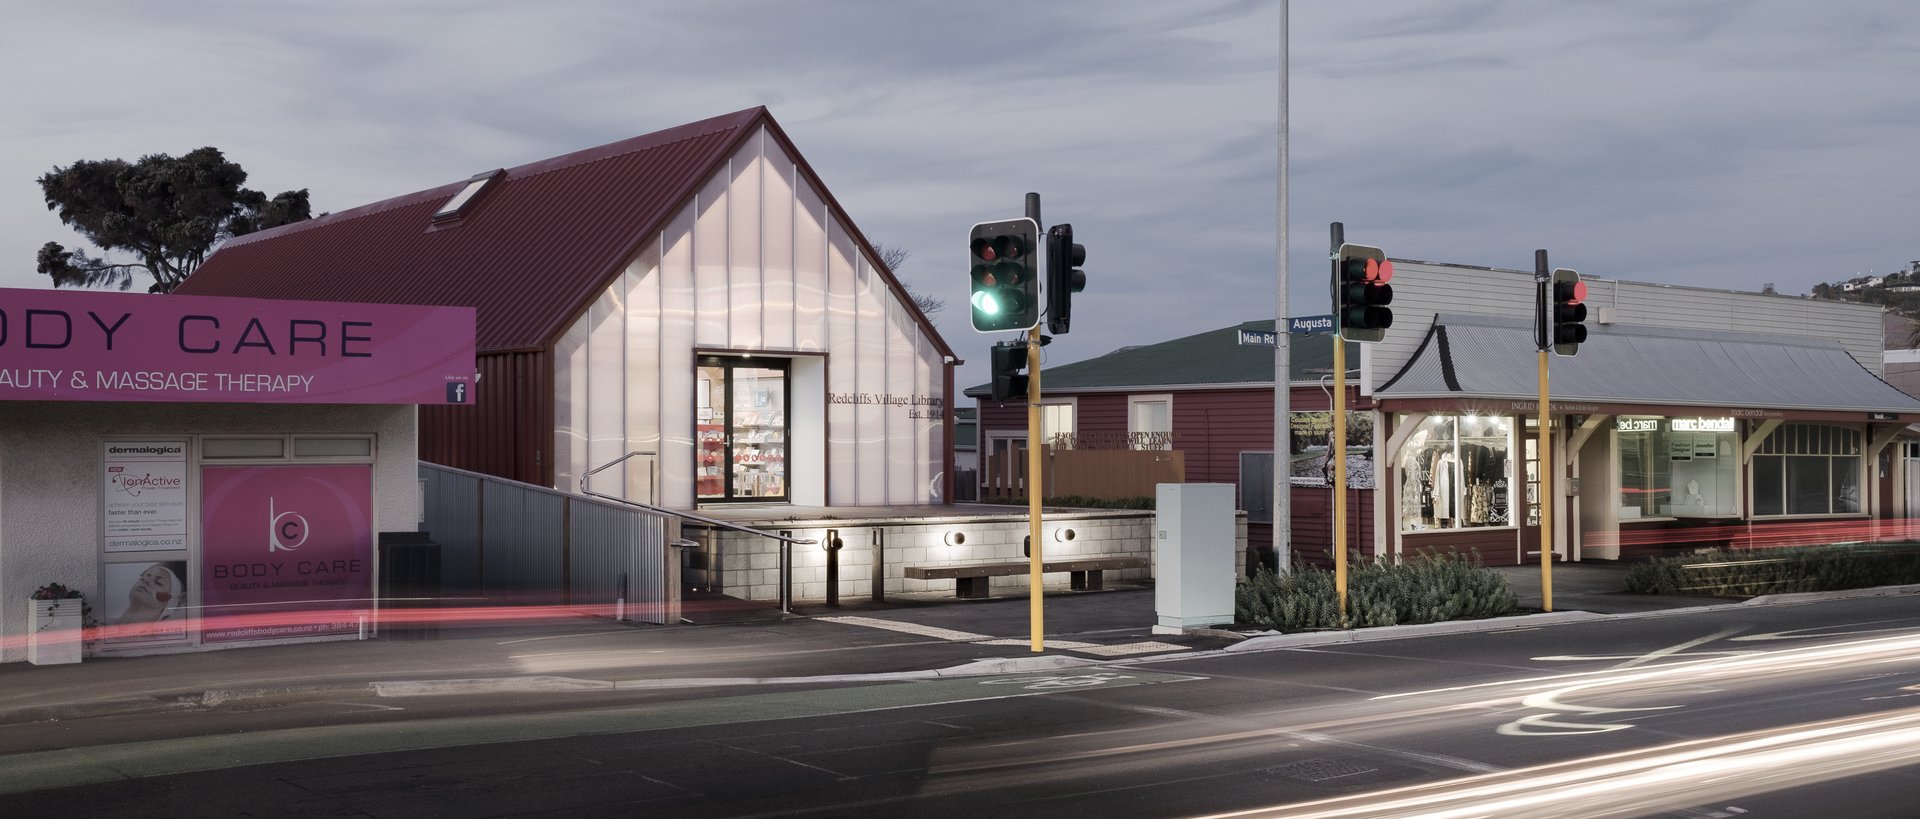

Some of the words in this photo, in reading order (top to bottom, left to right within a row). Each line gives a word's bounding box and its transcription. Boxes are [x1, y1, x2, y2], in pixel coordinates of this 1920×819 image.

[1293, 318, 1332, 331] Augusta
[0, 308, 132, 350] DY
[178, 315, 373, 357] CARE
[1243, 333, 1261, 343] Main
[1264, 334, 1274, 344] Rd
[0, 369, 62, 388] AUTY
[71, 371, 88, 389] &
[97, 371, 208, 391] MASSAGE
[214, 373, 314, 392] THERAPY
[828, 393, 872, 404] Redcliffs
[875, 393, 908, 407] Village
[911, 394, 944, 407] Library
[1511, 401, 1535, 410] INGRID
[909, 409, 922, 418] Est.
[926, 409, 944, 419] 1914
[1672, 419, 1698, 430] marc
[1698, 417, 1734, 430] bendall
[109, 446, 181, 455] dermalogica
[123, 476, 181, 486] IonActive
[109, 539, 182, 547] dermalogica.co.nz
[214, 562, 284, 578] BODY
[298, 559, 361, 575] CARE
[206, 625, 313, 638] www.redcliffsbodycare.co.nz
